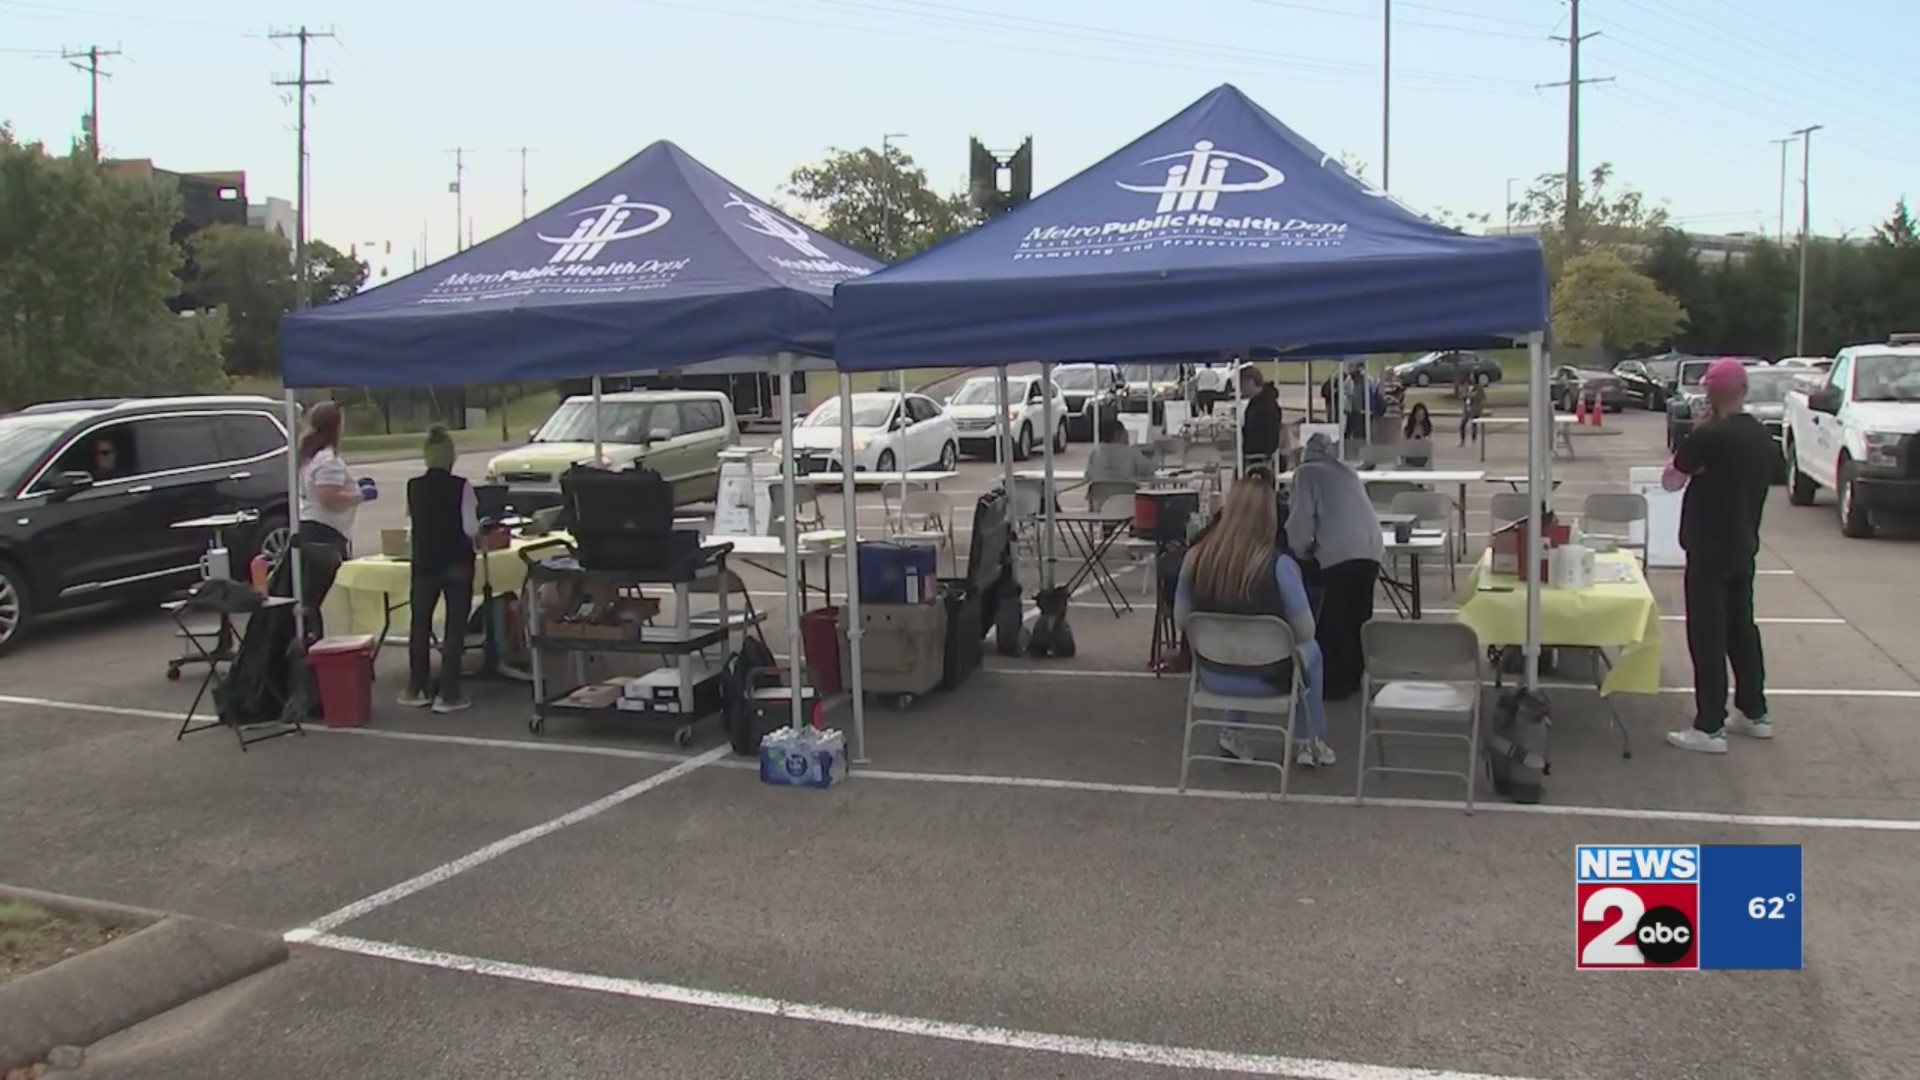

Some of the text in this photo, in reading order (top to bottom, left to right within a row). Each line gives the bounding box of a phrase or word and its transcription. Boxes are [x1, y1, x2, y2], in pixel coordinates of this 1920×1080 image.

[1023, 213, 1348, 241] Metro Public Health Dept
[499, 264, 563, 282] Public
[562, 261, 637, 277] Health
[635, 257, 690, 274] Dept
